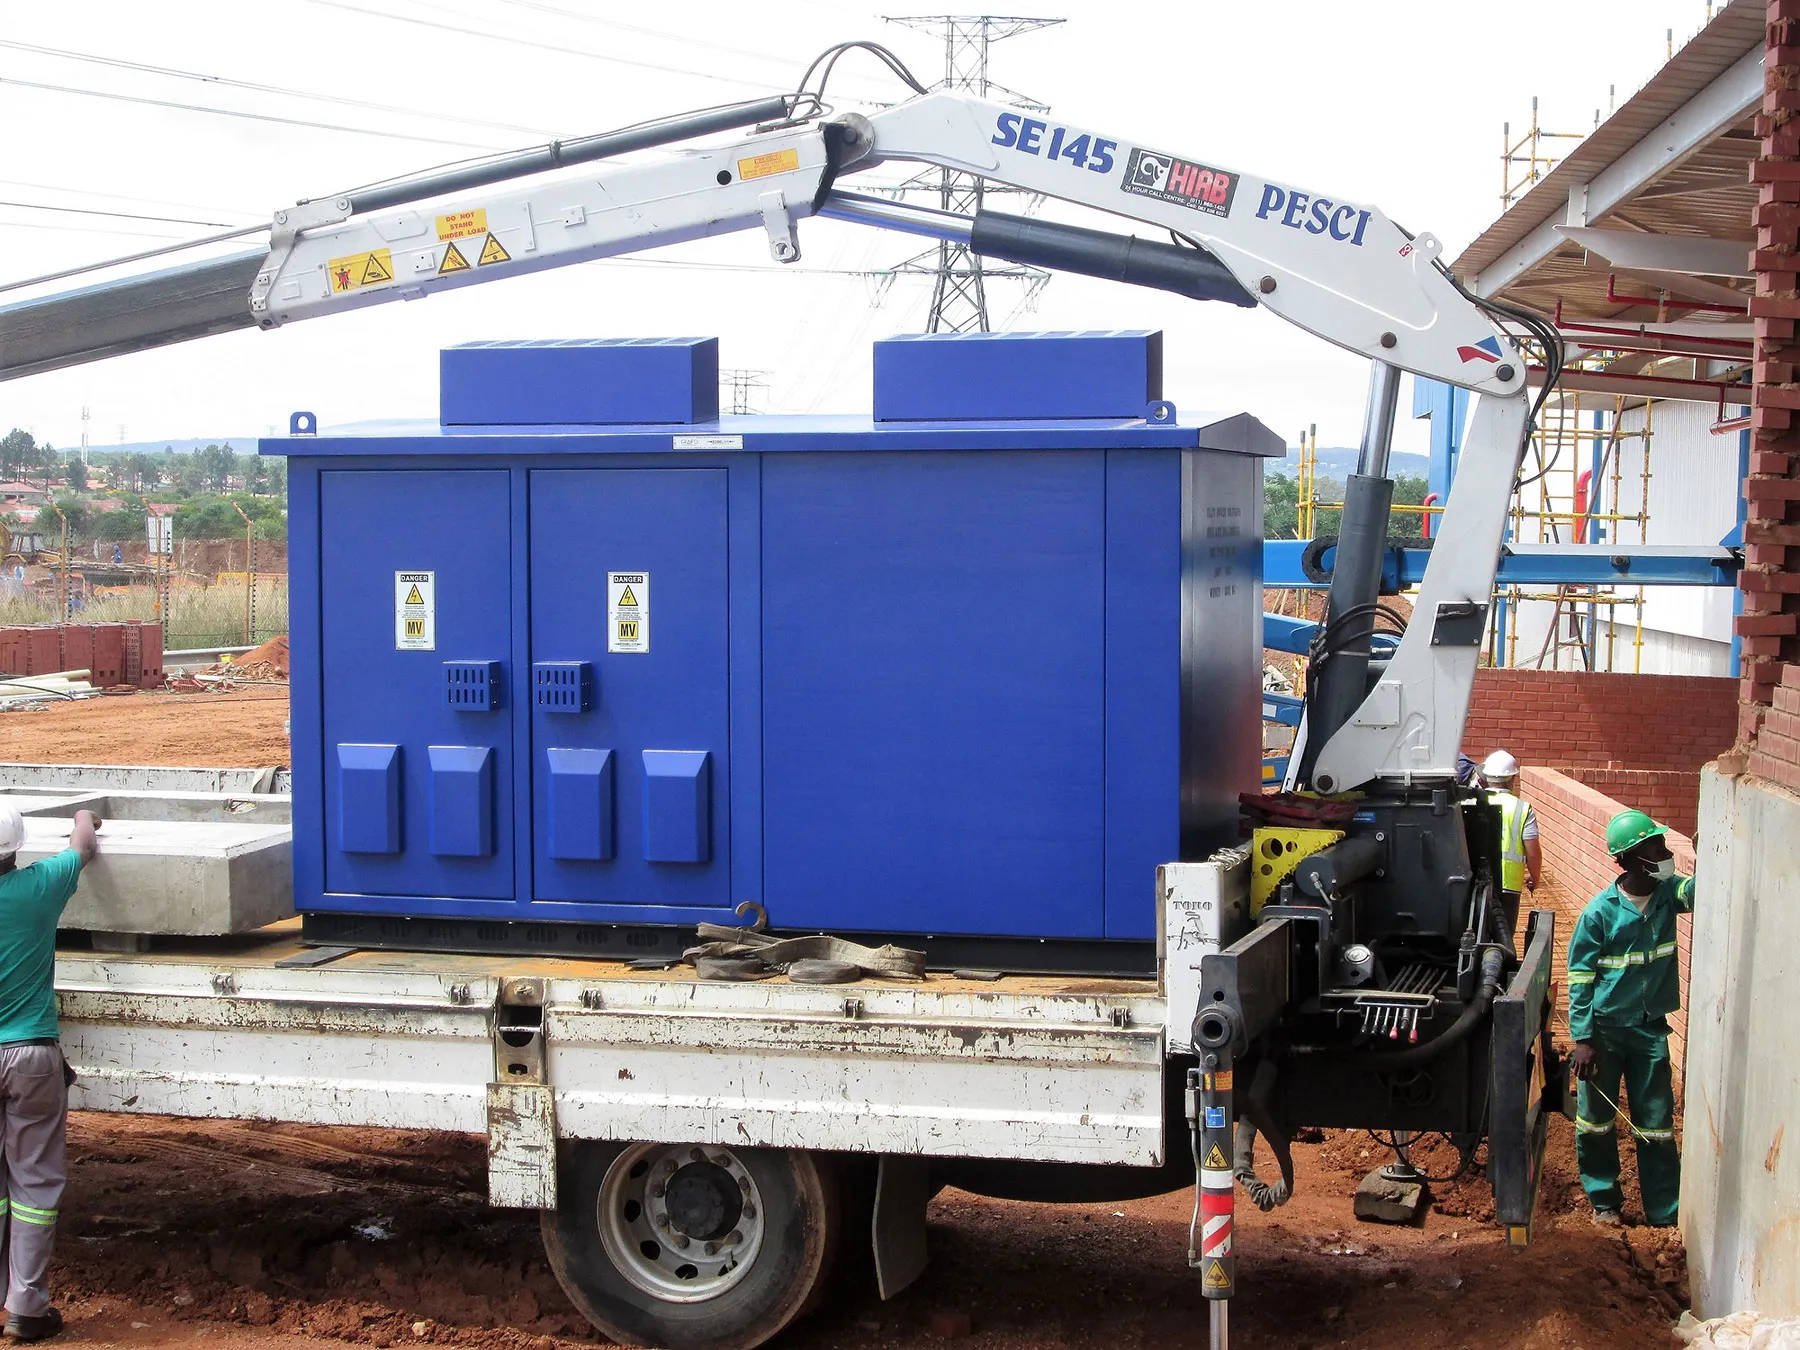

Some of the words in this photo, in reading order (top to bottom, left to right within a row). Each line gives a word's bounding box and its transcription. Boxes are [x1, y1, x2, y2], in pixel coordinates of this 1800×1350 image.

[1168, 161, 1230, 205] HIAB
[1132, 185, 1149, 194] HOUR
[1148, 189, 1163, 197] CALL
[460, 211, 475, 219] NOT
[1255, 183, 1371, 246] PESCI
[450, 220, 473, 230] STAND
[439, 231, 463, 240] UNDER
[468, 227, 486, 235] LOAD
[407, 621, 422, 634] MV
[620, 623, 636, 637] MV
